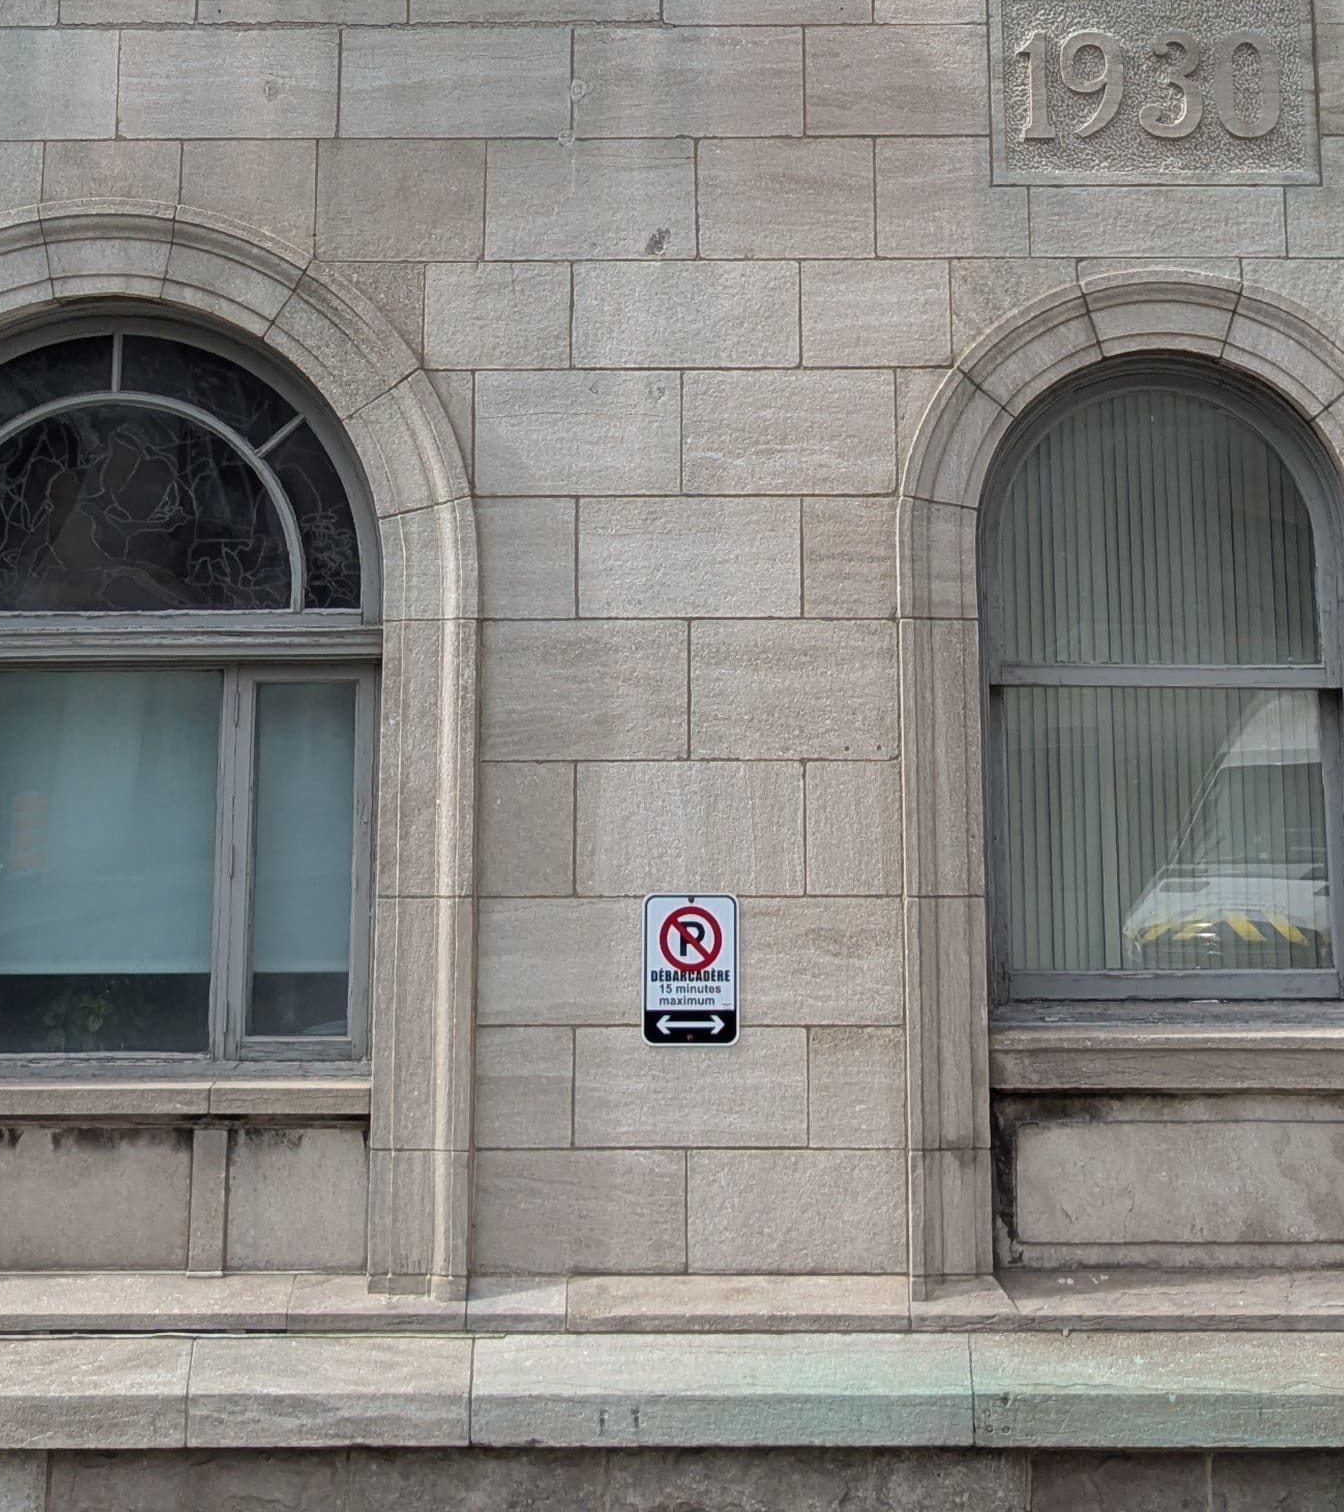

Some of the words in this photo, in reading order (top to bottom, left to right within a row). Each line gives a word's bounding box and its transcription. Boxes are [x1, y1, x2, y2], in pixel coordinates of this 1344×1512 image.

[1015, 30, 1281, 139] 1930
[650, 968, 730, 982] DÉBARCADÈRE
[659, 984, 673, 994] 15
[675, 984, 722, 994] minutes
[659, 995, 715, 1006] maximum
